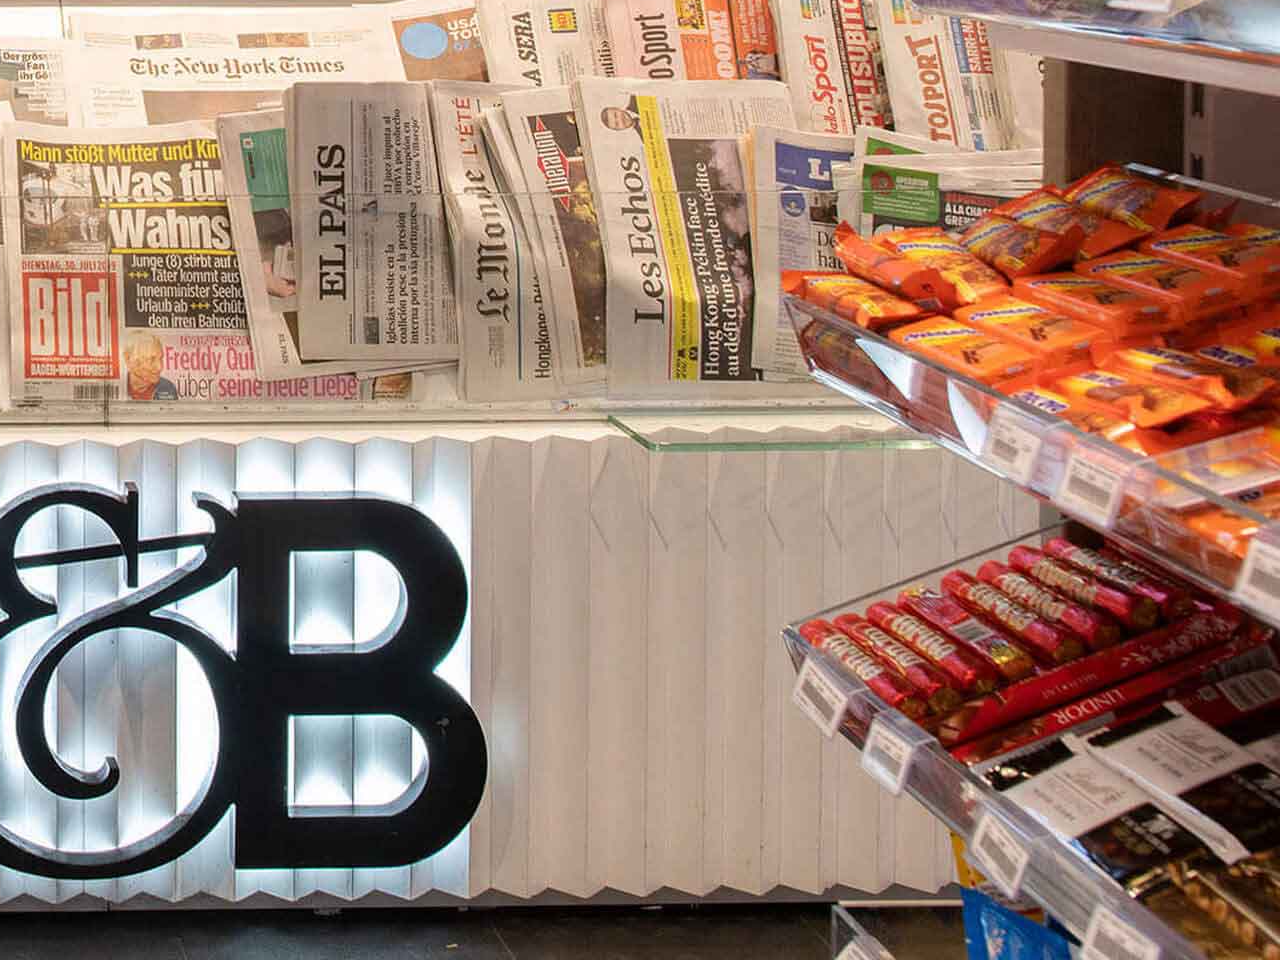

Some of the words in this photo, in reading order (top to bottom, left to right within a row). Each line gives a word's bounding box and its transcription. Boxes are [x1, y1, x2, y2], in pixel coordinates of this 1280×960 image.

[511, 10, 539, 64] SERA
[634, 12, 677, 65] Sport
[2, 52, 20, 62] Der
[26, 62, 46, 71] Fan
[129, 55, 171, 77] The
[174, 55, 221, 76] New
[225, 55, 276, 79] York
[279, 54, 345, 75] Times
[803, 34, 839, 105] Sport
[455, 96, 479, 156] L'ÉTÉ
[20, 141, 62, 163] Mann
[65, 144, 105, 164] stößt
[108, 143, 158, 164] Mutter
[163, 142, 193, 160] und
[93, 164, 172, 203] Was
[312, 143, 347, 237] PAÍS
[694, 161, 715, 217] inédite
[619, 155, 659, 258] Echos
[685, 197, 703, 229] face
[108, 207, 232, 250] Wahns
[463, 168, 510, 284] Monde
[708, 219, 729, 271] fronde
[130, 254, 163, 269] Junge
[165, 254, 182, 268] (8)
[183, 254, 211, 268] stirbt
[213, 254, 231, 268] auf
[385, 243, 396, 254] la
[396, 252, 406, 263] la
[692, 231, 713, 276] Pékin
[136, 284, 211, 298] Innenminister
[151, 270, 178, 283] Täter
[179, 270, 218, 283] kommt
[220, 272, 240, 283] aus
[319, 246, 347, 301] EL
[384, 270, 396, 305] insiste
[399, 273, 409, 297] pese
[408, 275, 418, 286] la
[136, 299, 172, 313] Urlaub
[173, 299, 188, 313] ab
[410, 286, 421, 307] por
[477, 287, 510, 325] Le
[634, 261, 666, 326] Les
[719, 272, 737, 319] d'une
[27, 277, 109, 356] Bild
[148, 314, 169, 328] den
[170, 314, 197, 328] irren
[384, 305, 397, 345] Iglesias
[396, 298, 407, 345] coalición
[408, 307, 419, 345] interna
[704, 328, 723, 376] Hong
[722, 321, 737, 353] défi
[164, 346, 223, 375] Freddy
[728, 353, 739, 376] au
[178, 377, 214, 398] über
[218, 378, 265, 398] seine
[312, 376, 359, 398] Liebe
[1053, 688, 1124, 726] LINDOR
